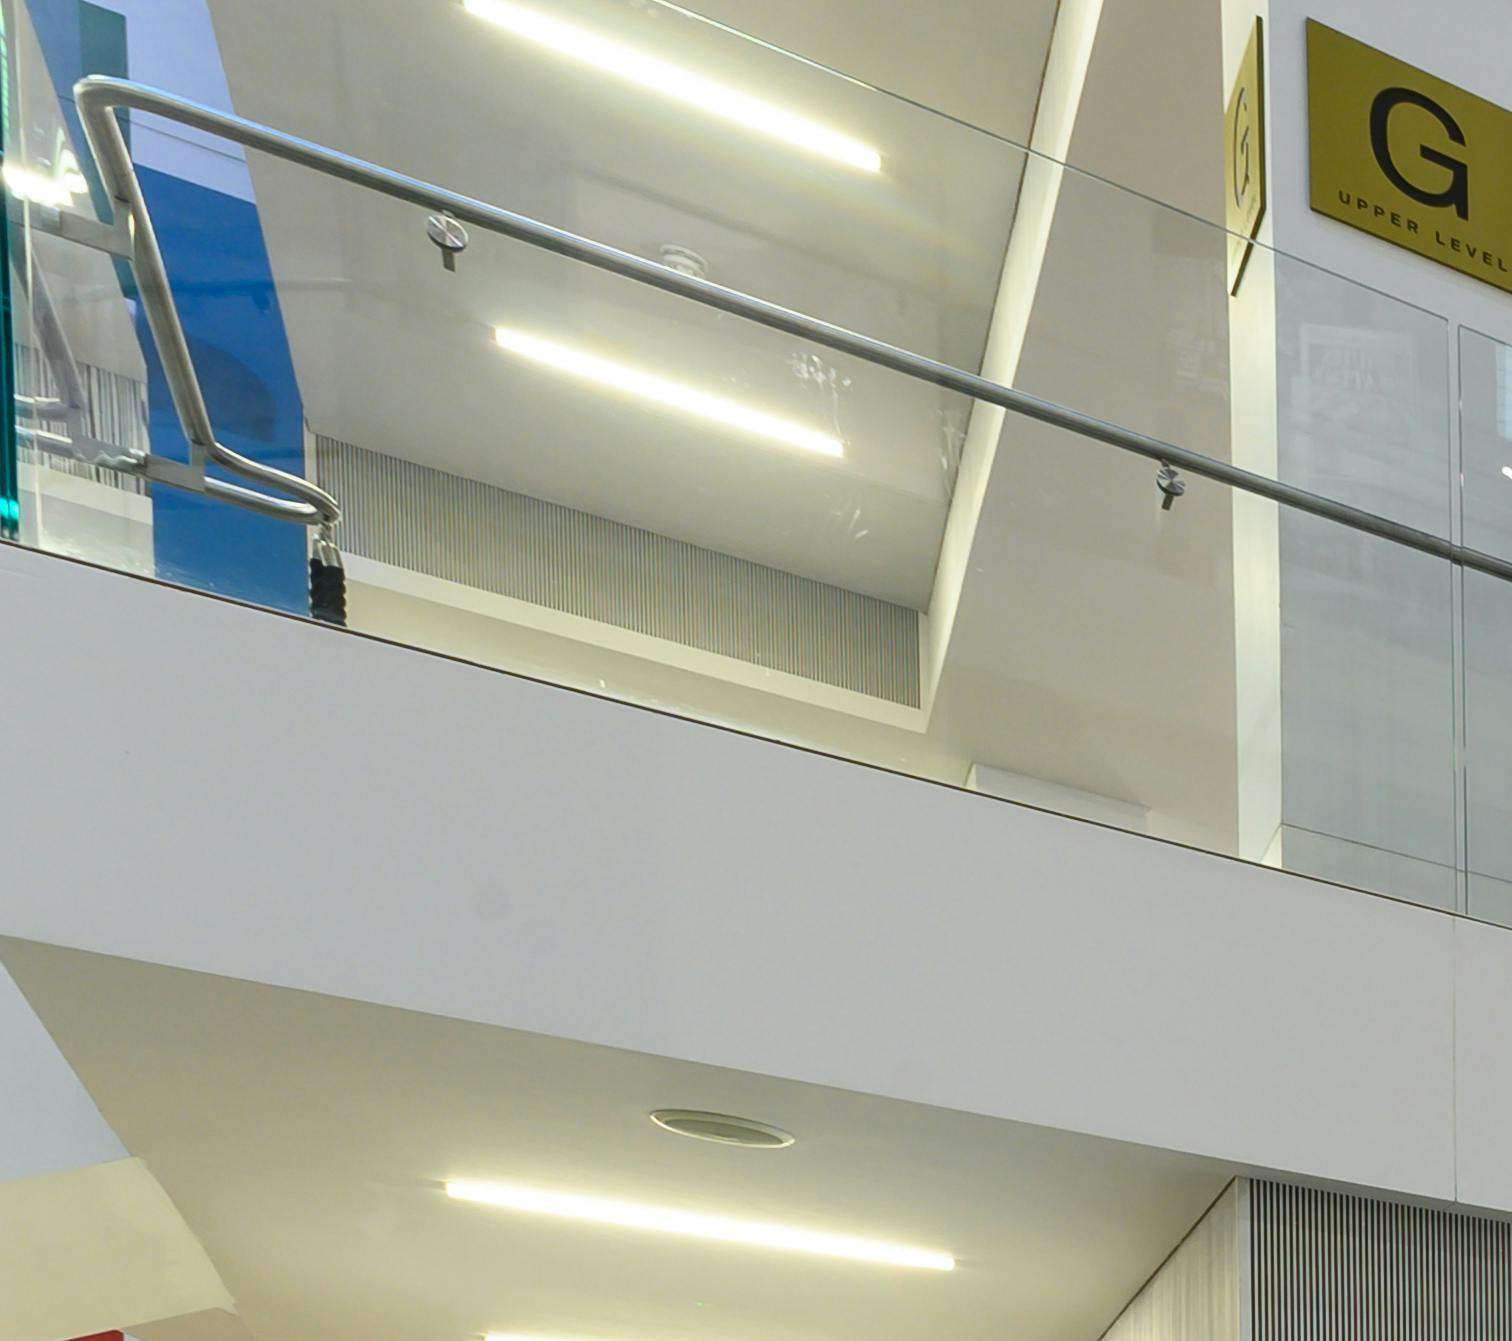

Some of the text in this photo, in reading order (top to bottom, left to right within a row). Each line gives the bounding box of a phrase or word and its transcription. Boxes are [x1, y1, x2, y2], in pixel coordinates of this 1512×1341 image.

[1369, 86, 1469, 221] G
[1338, 189, 1508, 273] UPPER LEVEL
